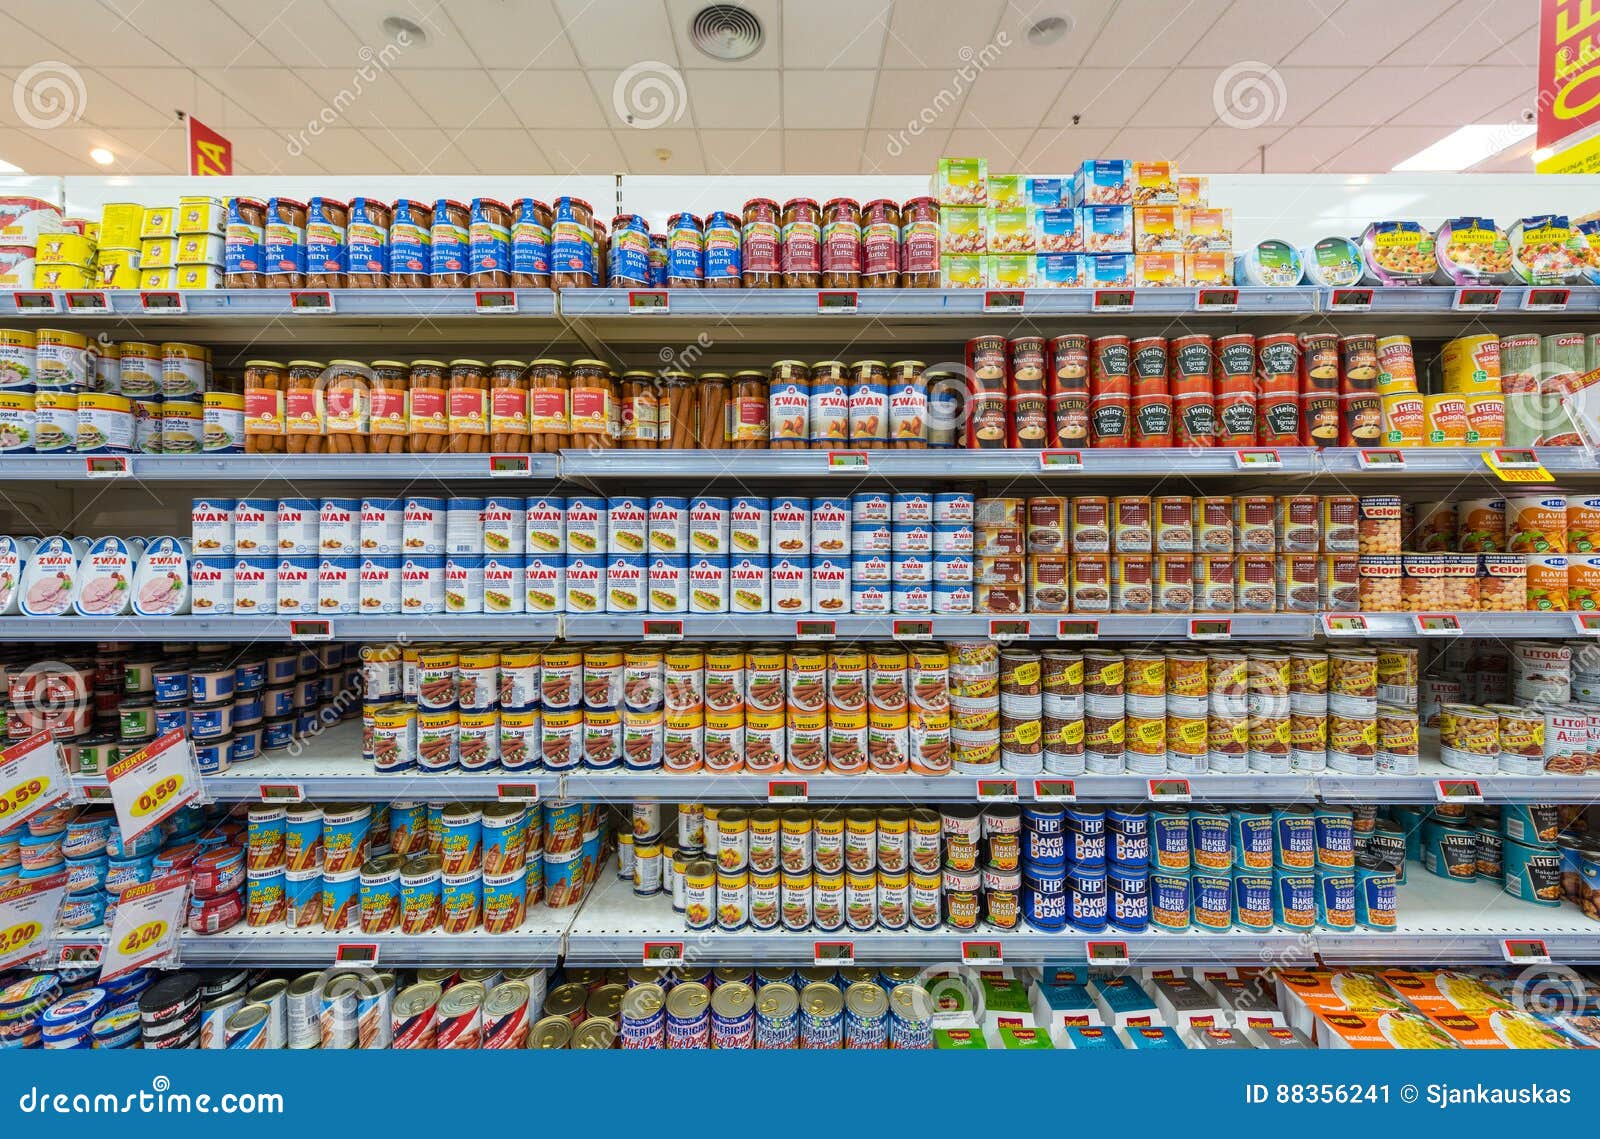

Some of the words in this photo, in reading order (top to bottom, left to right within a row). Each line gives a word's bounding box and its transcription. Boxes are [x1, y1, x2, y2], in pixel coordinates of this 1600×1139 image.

[976, 342, 1004, 352] HEINZ
[1015, 342, 1042, 352] HEINZ
[1059, 341, 1086, 351] HEINZ
[1185, 346, 1208, 356] Heinz
[1386, 346, 1412, 355] HEINZ
[1142, 347, 1163, 357] Heinz
[775, 397, 807, 406] ZWAN
[850, 397, 883, 406] ZWAN
[892, 398, 925, 407] ZWAN
[977, 401, 1004, 411] HEINZ
[1018, 401, 1045, 411] HEINZ
[1059, 401, 1086, 411] HEINZ
[1098, 407, 1121, 417] Heinz
[1144, 406, 1167, 415] Heinz
[528, 512, 561, 520] ZWAN
[773, 513, 805, 521] ZWAN
[813, 513, 845, 521] ZWAN
[38, 557, 71, 565] ZWAN
[92, 557, 127, 565] ZWAN
[149, 557, 181, 565] ZWAN
[732, 571, 763, 579] ZWAN
[772, 571, 803, 579] ZWAN
[813, 571, 844, 579] ZWAN
[1343, 677, 1372, 687] ALBO
[1333, 735, 1362, 744] ALBO
[113, 751, 148, 776] OFERTA
[139, 778, 177, 810] 0,59
[1039, 820, 1057, 831] HP
[1085, 820, 1103, 831] HP
[1127, 821, 1144, 832] HP
[1031, 832, 1064, 848] BAKED
[1202, 838, 1226, 846] BAKED
[1326, 836, 1352, 845] BAKED
[1372, 837, 1404, 848] HEINZ
[1203, 844, 1227, 852] BEANS
[1326, 843, 1351, 851] BEANS
[1043, 880, 1061, 892] HP
[1082, 880, 1100, 891] HP
[1124, 880, 1144, 891] HP
[125, 883, 156, 901] OFERTA
[1160, 896, 1183, 904] BAKED
[1159, 902, 1185, 910] BEANS
[126, 923, 162, 950] 2,00
